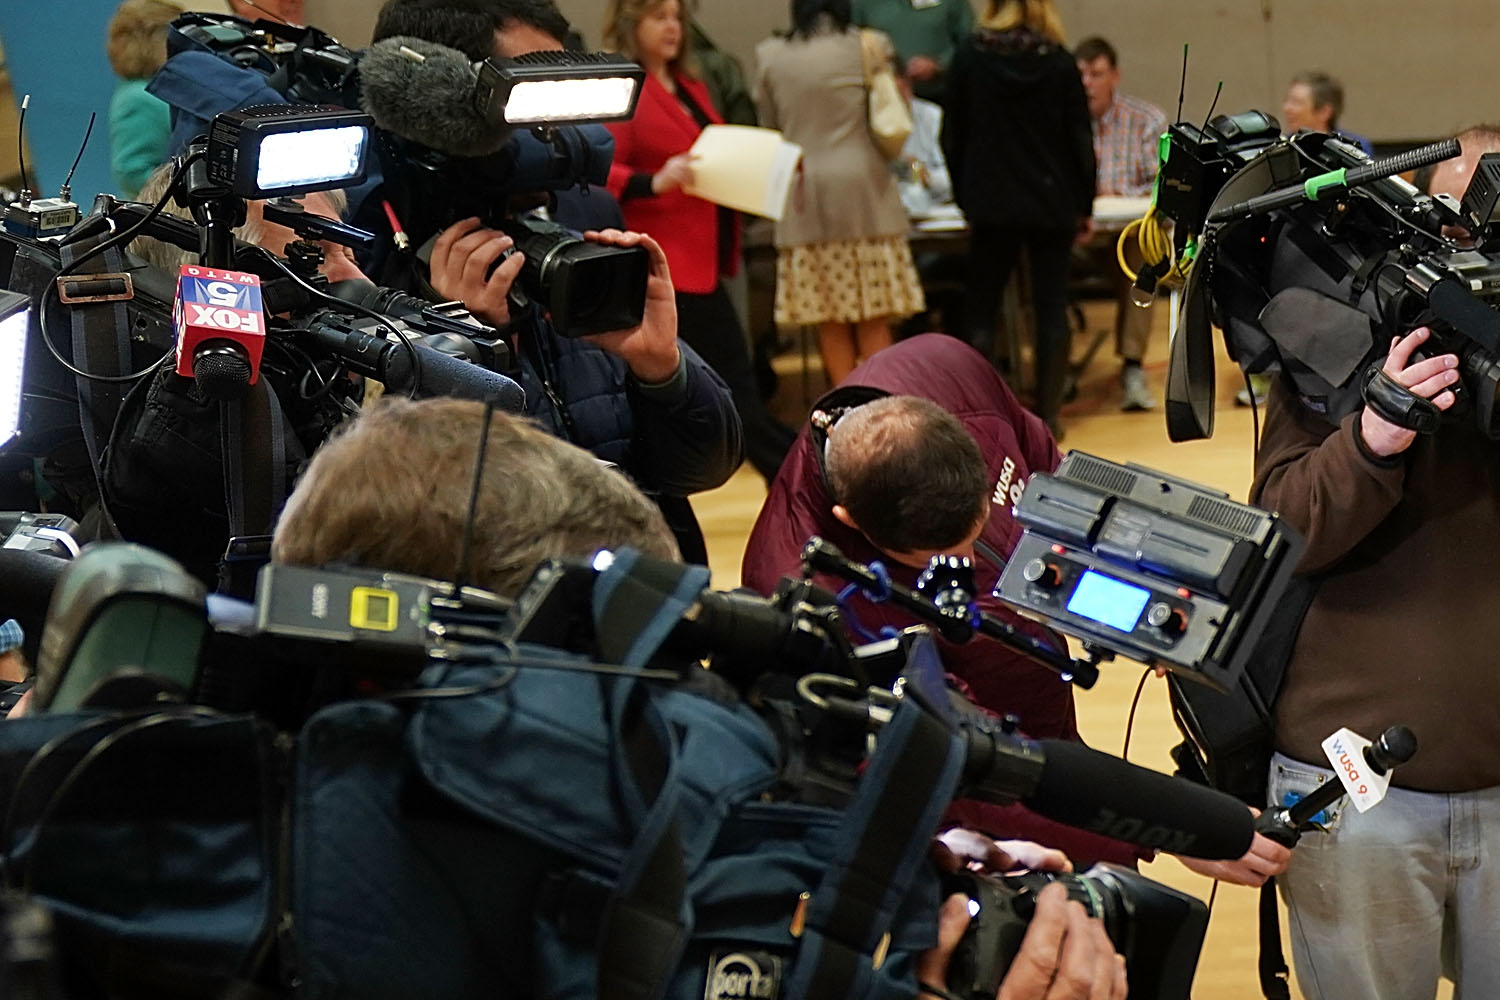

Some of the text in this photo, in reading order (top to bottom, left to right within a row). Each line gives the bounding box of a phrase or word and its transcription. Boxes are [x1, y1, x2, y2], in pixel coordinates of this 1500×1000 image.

[207, 281, 238, 308] 5
[191, 304, 260, 333] FOX
[992, 456, 1015, 506] wusa
[1332, 738, 1368, 795] wusa 9
